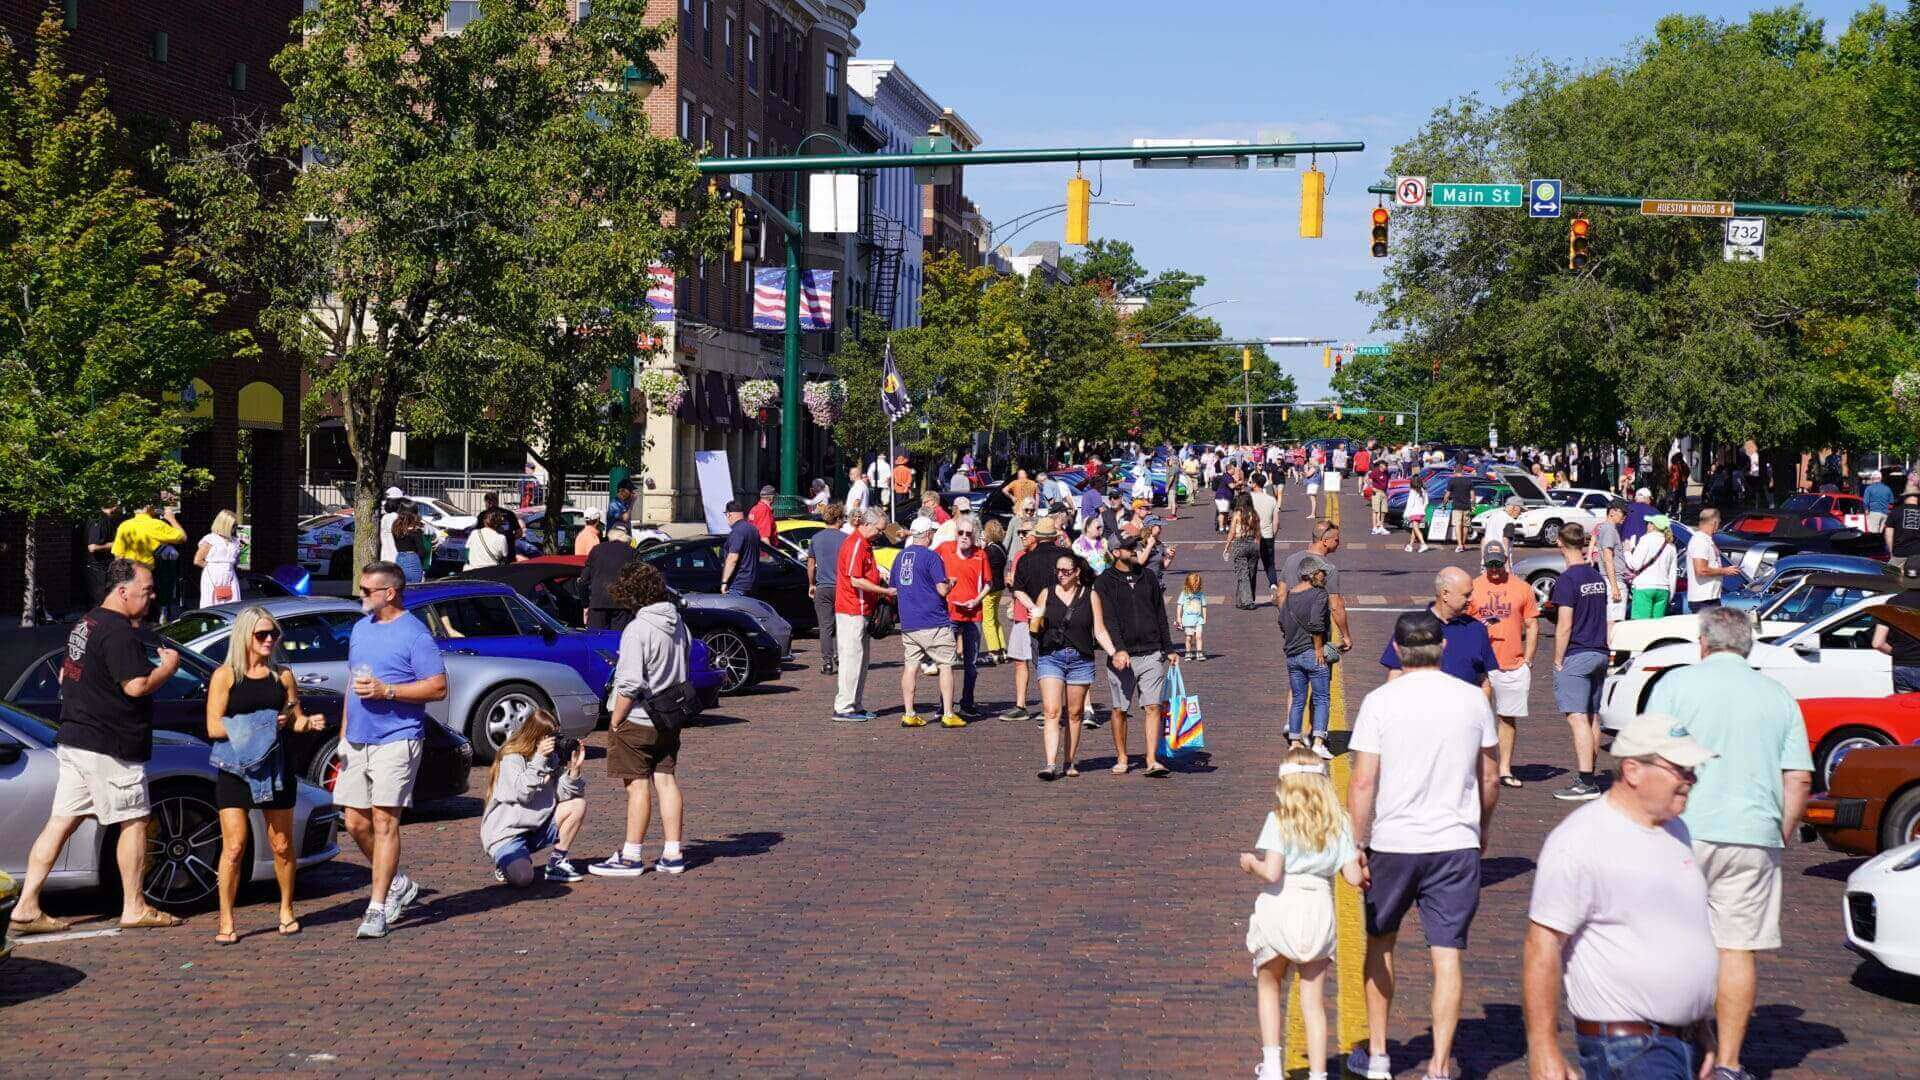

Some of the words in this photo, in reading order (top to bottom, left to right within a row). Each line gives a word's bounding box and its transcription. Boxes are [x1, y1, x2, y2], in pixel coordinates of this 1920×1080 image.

[1443, 188, 1484, 202] Main
[1492, 189, 1511, 203] St
[1657, 202, 1688, 213] HUESTON
[1691, 203, 1715, 214] WOODS
[1731, 226, 1759, 239] 732
